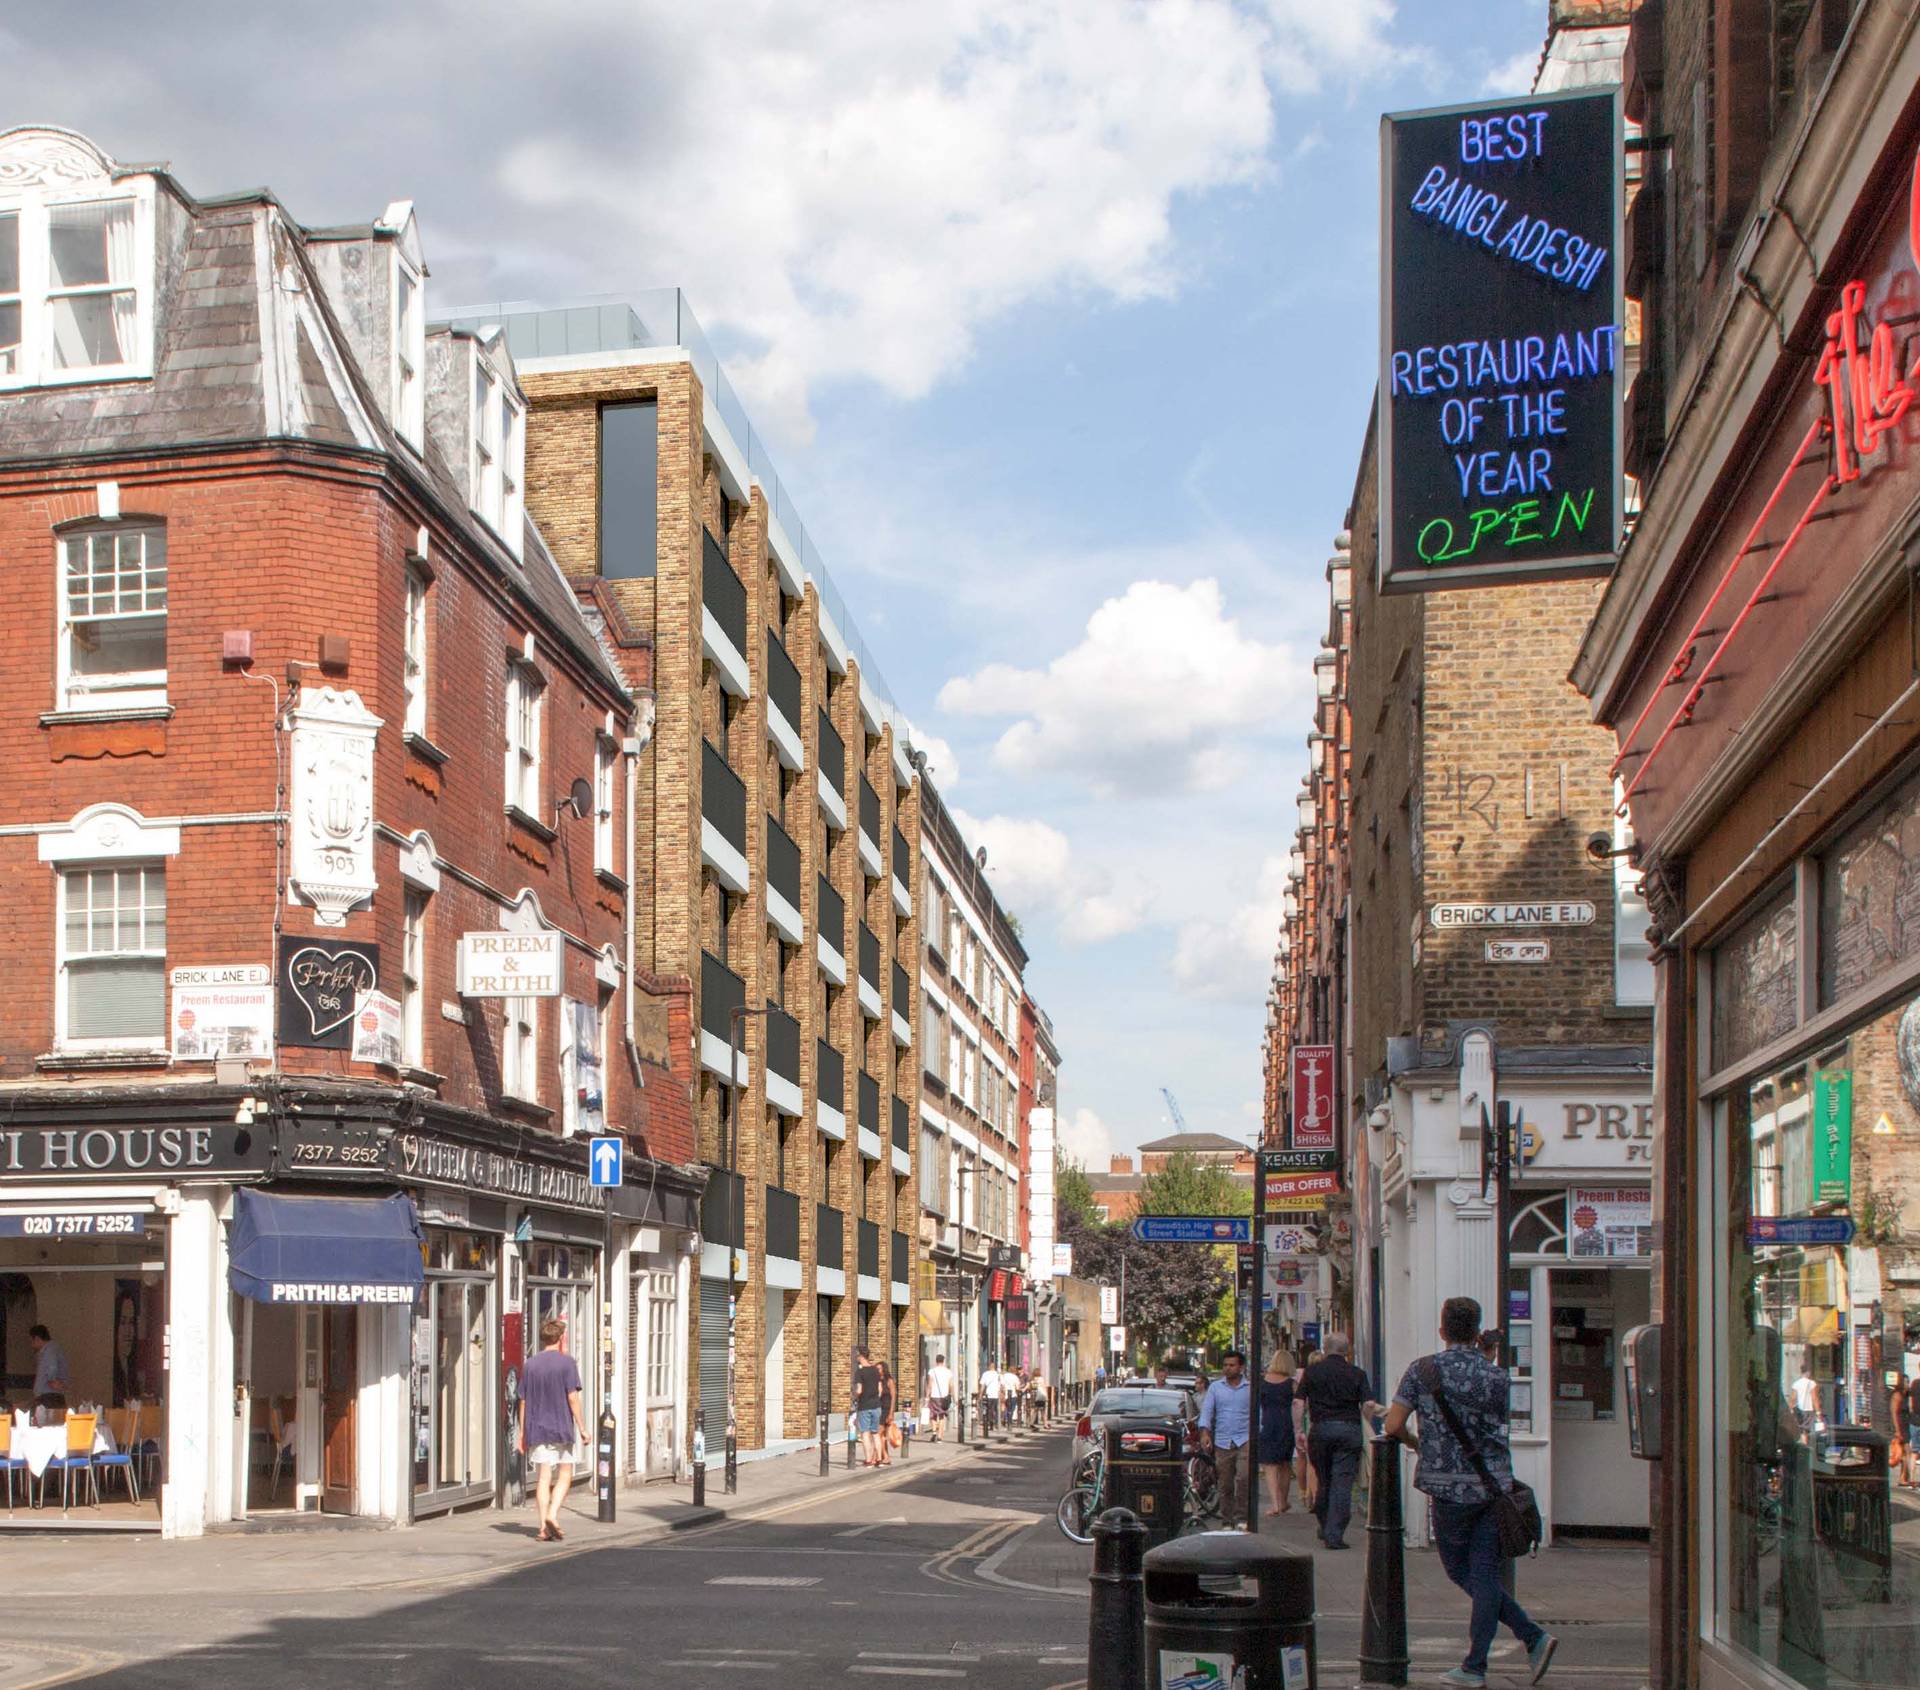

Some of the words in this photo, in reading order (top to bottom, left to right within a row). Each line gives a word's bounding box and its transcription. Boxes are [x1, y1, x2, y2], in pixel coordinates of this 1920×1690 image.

[1461, 112, 1549, 164] BEST
[1411, 165, 1607, 291] BANGLADESHI
[1391, 325, 1621, 398] RESTAURANT
[1440, 398, 1486, 445] OF
[1499, 390, 1568, 438] THE
[1455, 448, 1553, 498] YEAR
[1416, 488, 1595, 565] OPEN
[1440, 906, 1497, 923] BRICK
[1503, 905, 1553, 922] LANE
[471, 937, 553, 953] PREEM
[503, 956, 520, 972] &
[174, 971, 208, 984] BRICK
[212, 970, 245, 983] LANE
[471, 975, 553, 991] PRITHI
[181, 994, 211, 1006] Preem
[212, 994, 266, 1006] Restaurant
[1296, 1050, 1331, 1058] QUALITY
[0, 1131, 24, 1169] I
[39, 1127, 215, 1169] HOUSE
[1296, 1135, 1332, 1145] SHISHA
[294, 1143, 334, 1160] 7377
[341, 1146, 379, 1163] 5252
[1265, 1153, 1326, 1167] KEMSLEY
[1265, 1181, 1296, 1195] NDER
[1298, 1178, 1332, 1191] OFFER
[1576, 1189, 1615, 1202] Preem
[23, 1216, 52, 1234] 020
[55, 1215, 94, 1233] 7377
[96, 1215, 135, 1233] 5252
[1148, 1221, 1191, 1230] Shoreditch
[1193, 1221, 1211, 1232] High
[1148, 1230, 1174, 1238] Street
[1176, 1229, 1207, 1238] Station
[272, 1283, 415, 1303] PRITHI&PREEM
